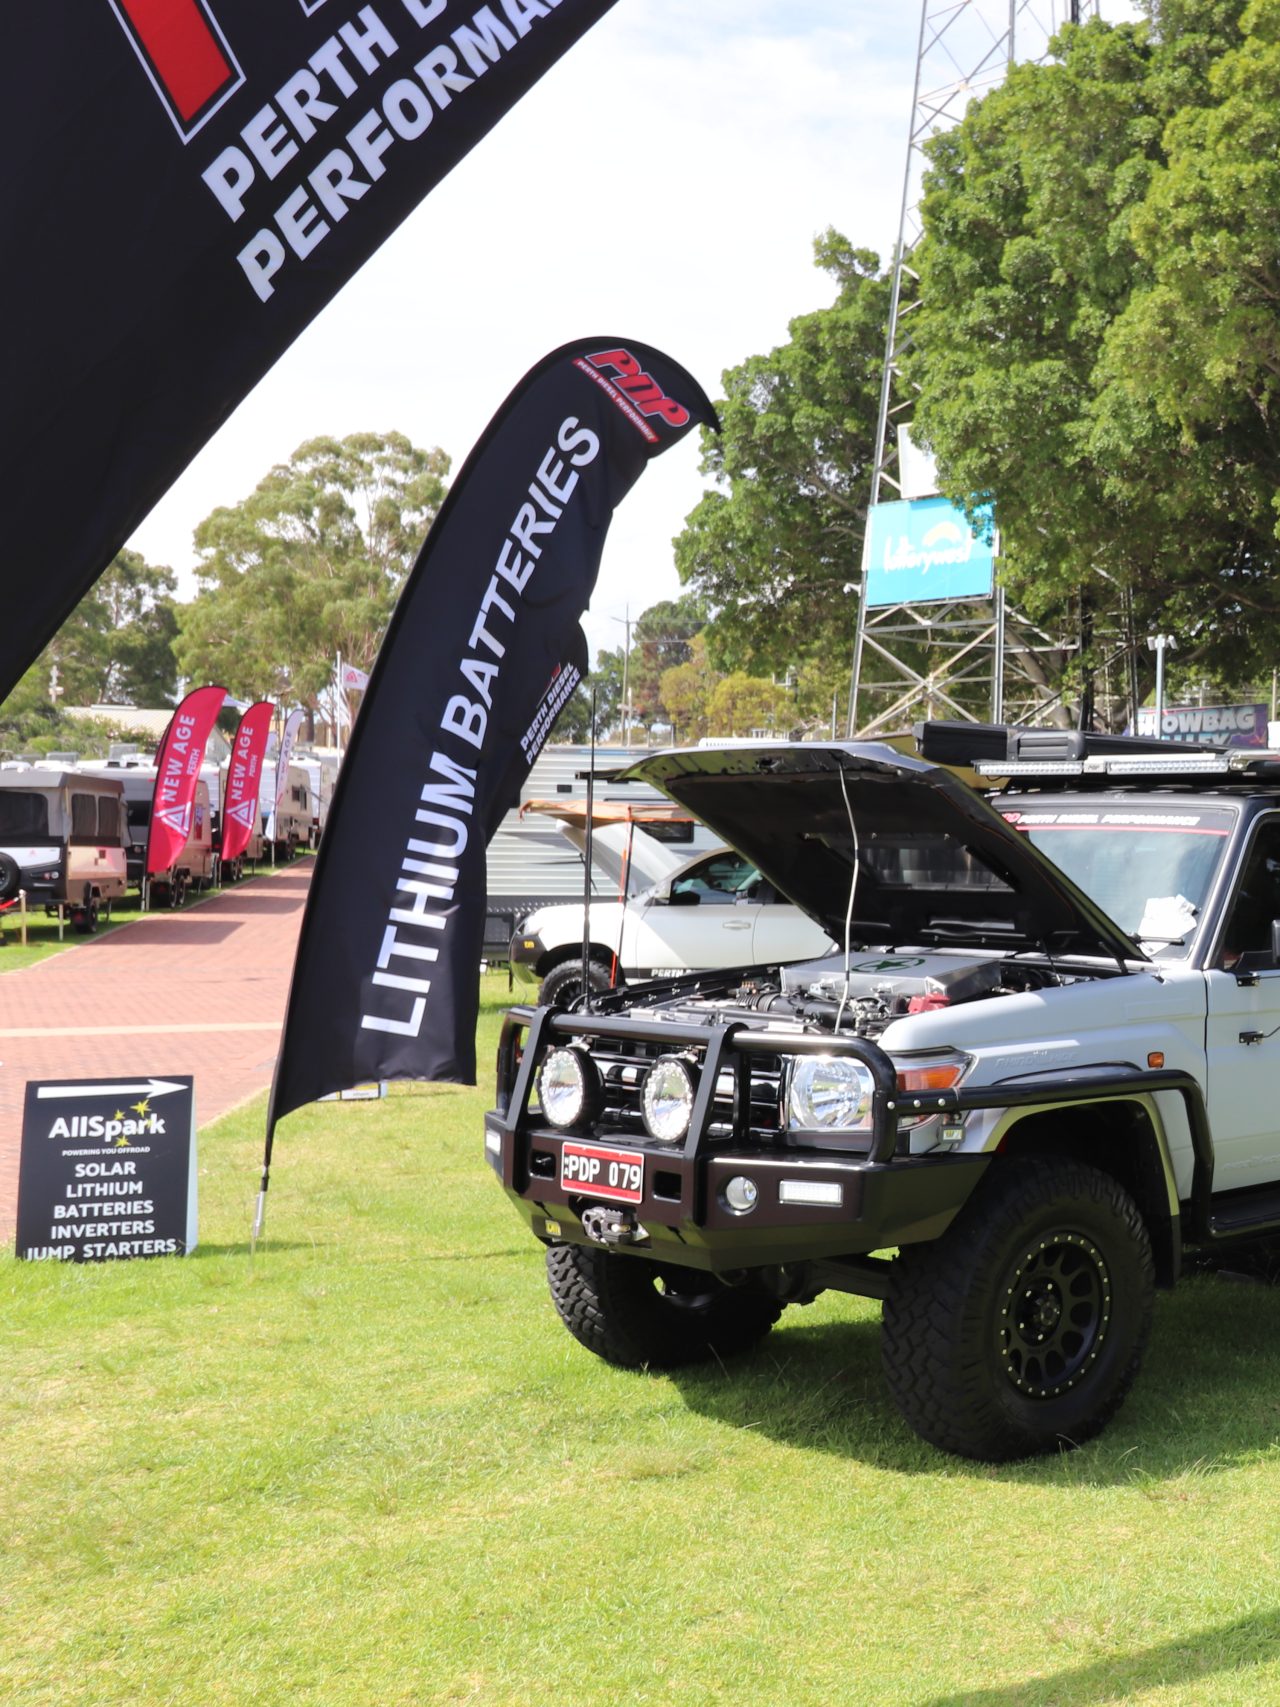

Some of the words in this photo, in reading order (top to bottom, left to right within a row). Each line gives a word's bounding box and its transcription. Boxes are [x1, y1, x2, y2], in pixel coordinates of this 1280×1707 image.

[201, 4, 400, 223] PERTH
[236, 0, 564, 303] PERFORMA
[584, 348, 690, 428] PDP
[520, 703, 548, 752] PERTH
[547, 662, 574, 706] DIESEL
[526, 667, 581, 765] PERFORMANCE
[172, 714, 195, 756] AGE
[361, 751, 479, 1038] LITHIUM
[440, 415, 600, 751] BATTERIES
[161, 757, 184, 802] NEW
[187, 748, 200, 776] PERTH
[231, 763, 247, 801] NEW
[239, 726, 254, 759] AGE
[651, 968, 684, 978] PERTH
[48, 1113, 166, 1143] AllSpark
[61, 1148, 101, 1157] POWERING
[101, 1147, 117, 1156] YOU
[117, 1145, 151, 1155] OFFROAD
[74, 1161, 136, 1178] SOLAR
[568, 1154, 601, 1183] PDP
[609, 1161, 641, 1190] 079
[66, 1181, 143, 1199] LITHIUM
[53, 1200, 154, 1219] BATTERIES
[51, 1220, 155, 1240] INVERTERS
[25, 1244, 76, 1262] JUMP
[82, 1238, 177, 1258] STARTERS
